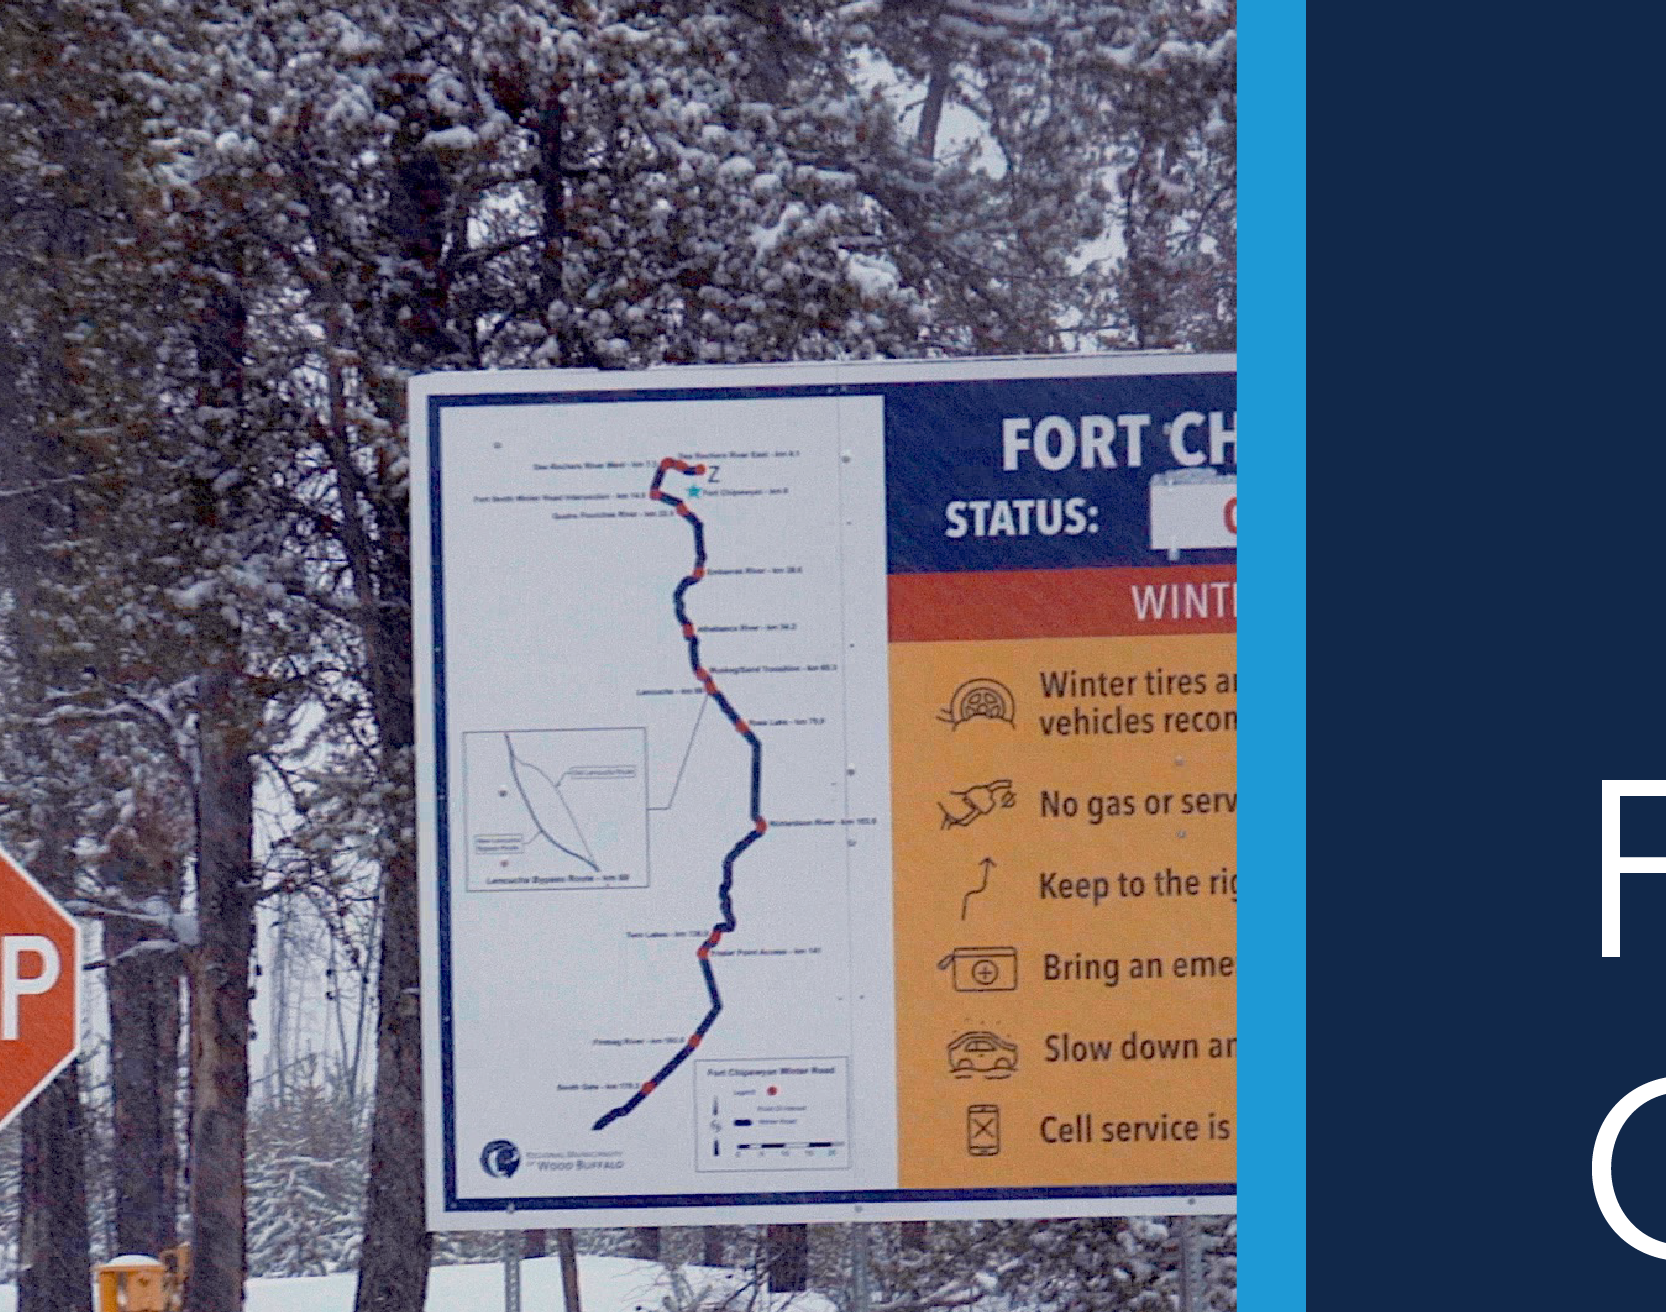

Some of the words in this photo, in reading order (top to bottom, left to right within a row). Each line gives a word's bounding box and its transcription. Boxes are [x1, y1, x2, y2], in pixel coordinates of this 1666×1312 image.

[1002, 413, 1151, 471] FORT
[945, 497, 1099, 539] STATUS:
[1131, 581, 1237, 620] WINT
[1039, 670, 1137, 698] Winter
[1144, 668, 1206, 695] tires
[1216, 673, 1237, 694] a
[1039, 707, 1154, 737] vehicles
[1040, 790, 1078, 818] No
[1087, 793, 1134, 826] gas
[1145, 793, 1174, 815] or
[1040, 872, 1109, 906] Keep
[1117, 873, 1145, 898] to
[1155, 867, 1200, 896] the
[1043, 953, 1120, 988] Bring
[1128, 956, 1163, 979] an
[1044, 1033, 1111, 1063] Slow
[1120, 1031, 1199, 1060] down
[1039, 1113, 1093, 1144] Cell
[1101, 1115, 1199, 1143] service
[1208, 1112, 1230, 1140] is
